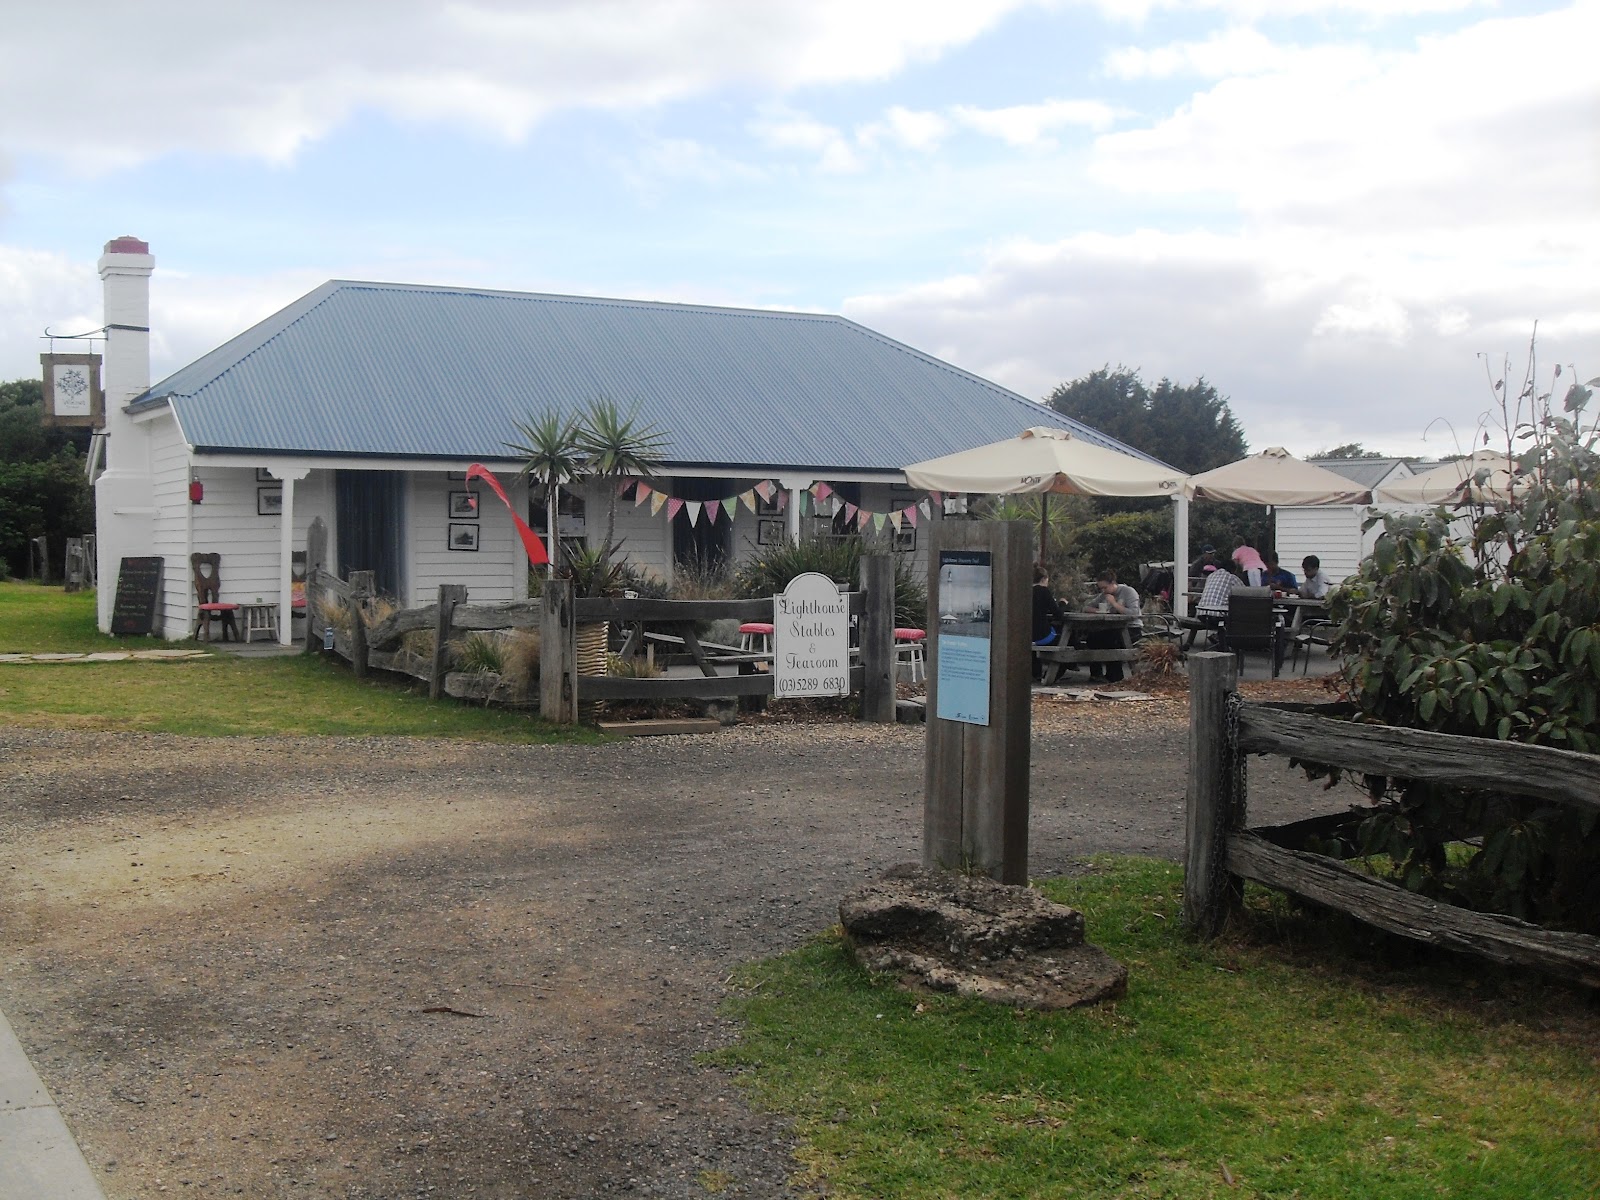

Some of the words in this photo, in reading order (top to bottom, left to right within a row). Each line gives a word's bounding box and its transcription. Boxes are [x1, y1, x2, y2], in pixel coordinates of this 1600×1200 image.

[779, 598, 845, 619] Lighthouse
[789, 621, 835, 638] Stables
[808, 643, 816, 654] &
[785, 652, 839, 670] Tearoom
[823, 676, 846, 690] 6830
